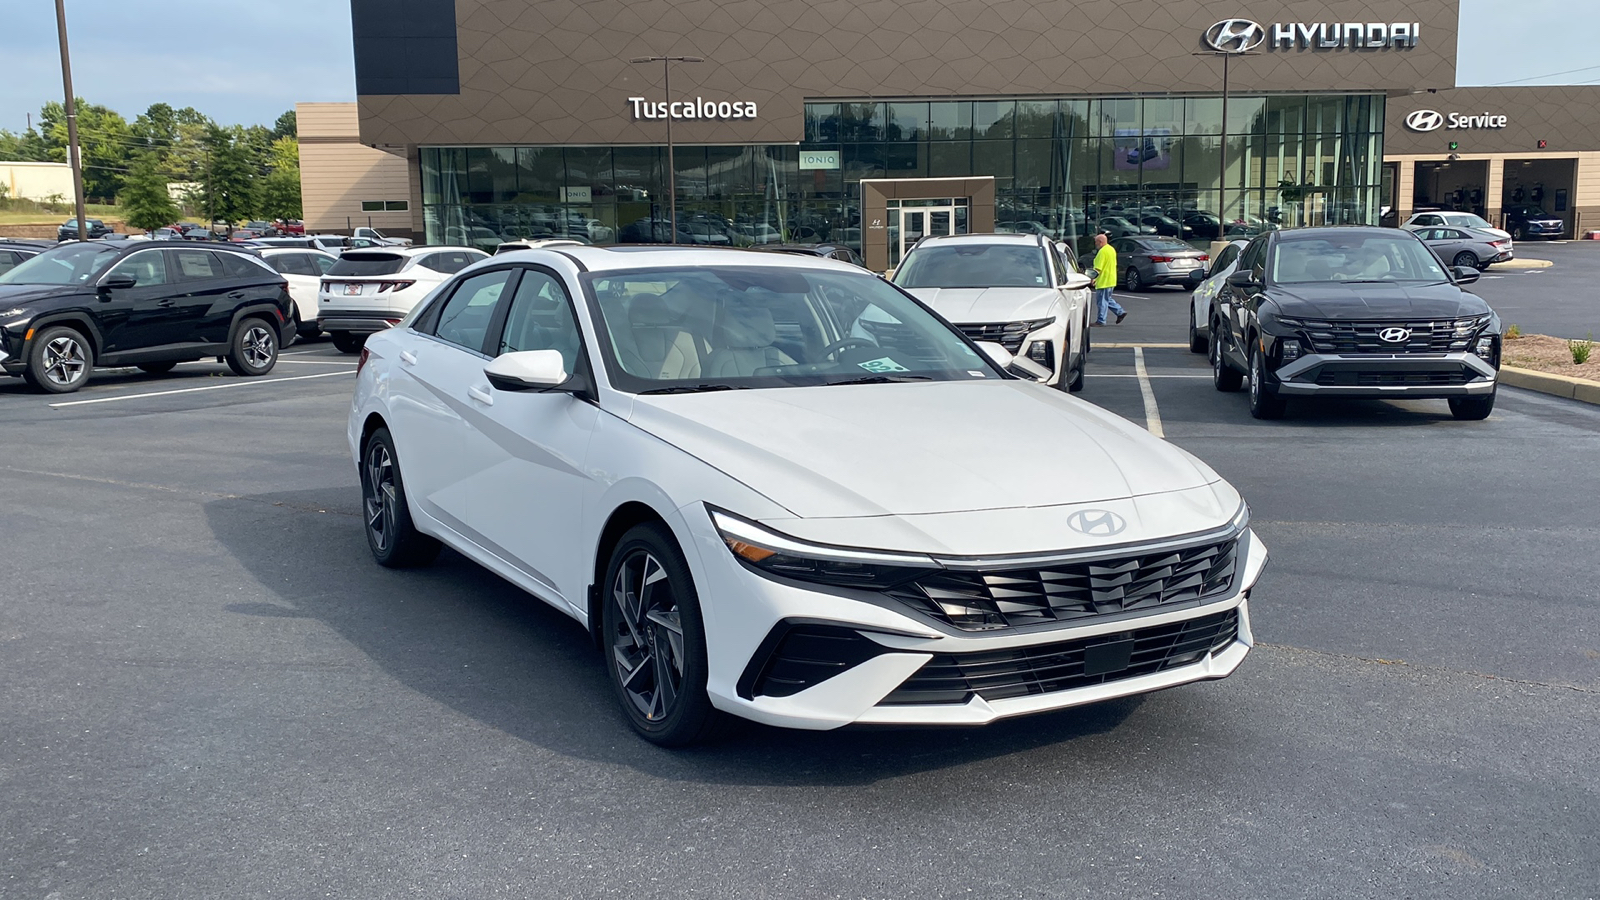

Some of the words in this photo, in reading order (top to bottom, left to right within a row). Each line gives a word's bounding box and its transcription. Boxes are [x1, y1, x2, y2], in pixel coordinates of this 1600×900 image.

[1274, 22, 1420, 48] HYUNDAI
[628, 96, 758, 119] Tuscaloosa
[1447, 111, 1508, 129] Service
[803, 156, 835, 164] IONIQ
